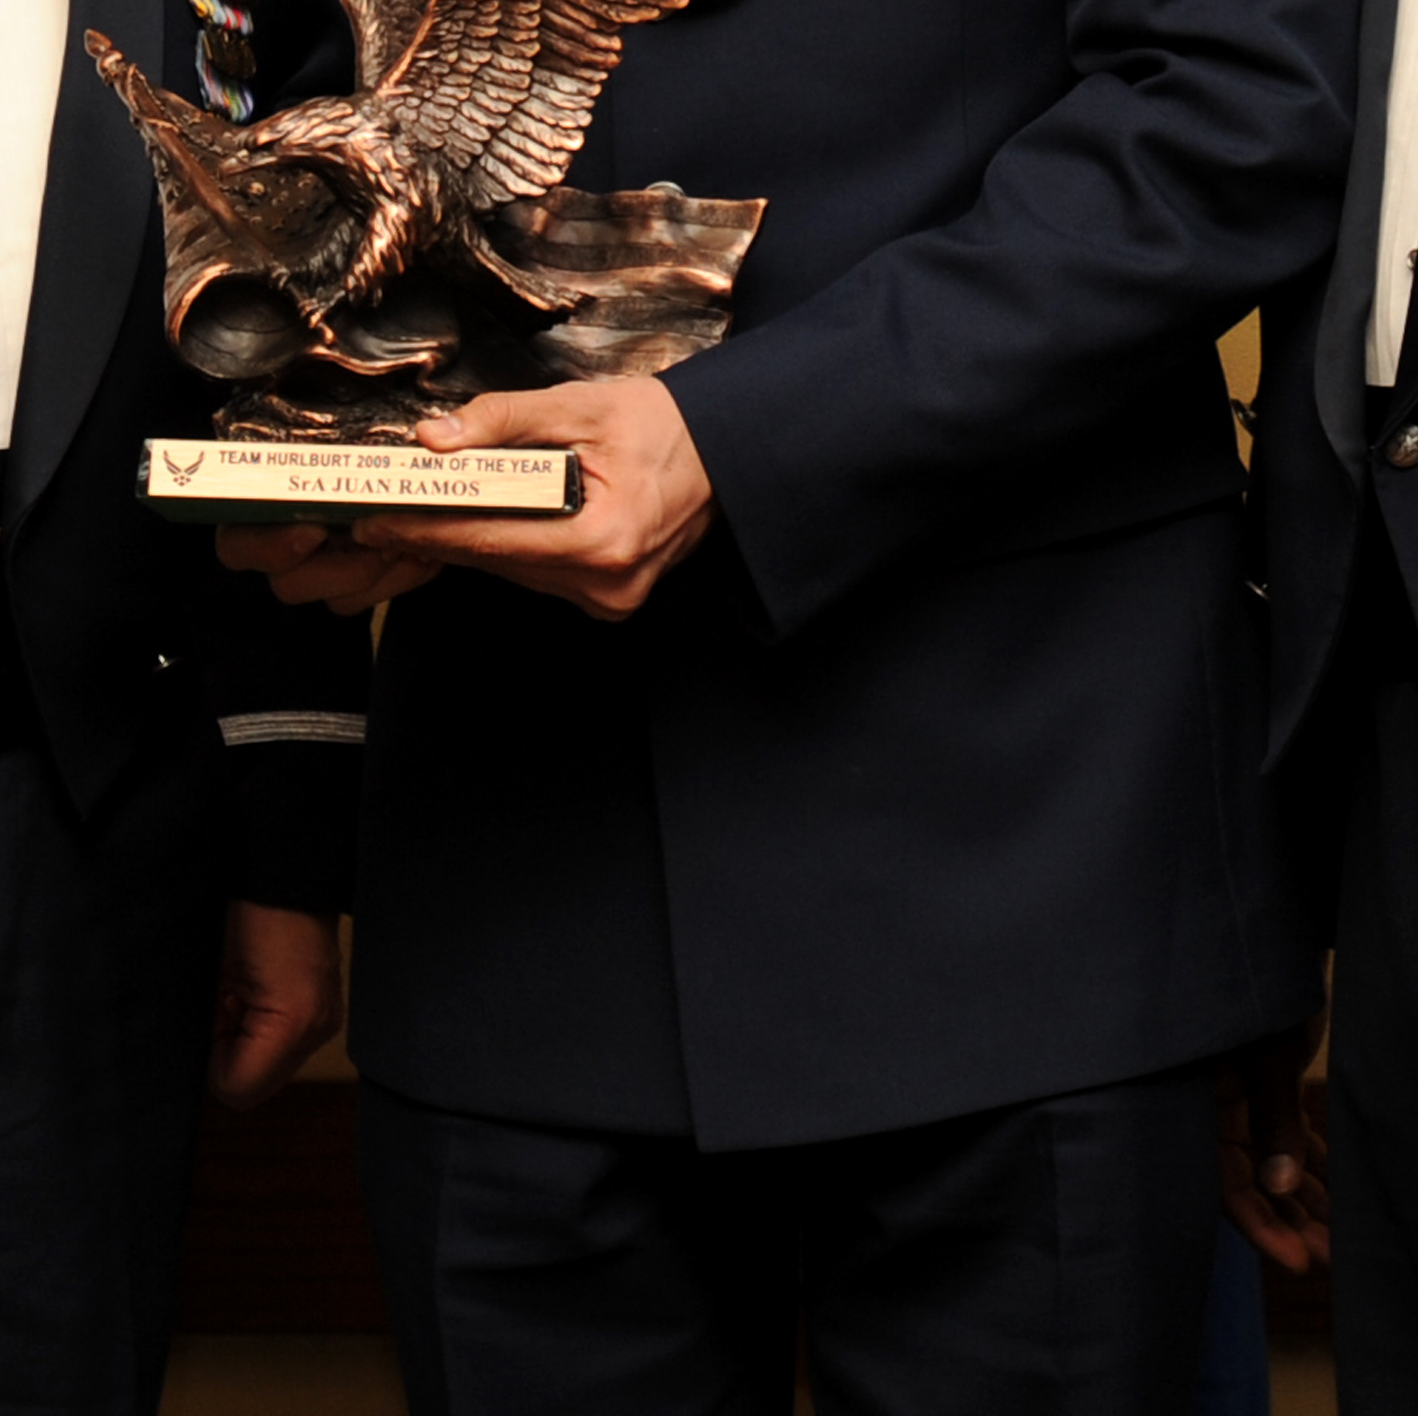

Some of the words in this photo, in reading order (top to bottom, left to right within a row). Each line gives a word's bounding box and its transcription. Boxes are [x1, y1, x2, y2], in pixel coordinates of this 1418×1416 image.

[219, 450, 261, 464] TEAM
[266, 452, 351, 467] HURLBURT
[356, 455, 391, 469] 2009
[410, 456, 444, 470] AMN
[449, 457, 471, 470] OF
[476, 458, 505, 473] THE
[511, 459, 552, 473] YEAR
[288, 475, 325, 492] SrA
[331, 477, 392, 494] JUAN
[398, 479, 480, 497] RAMOS
